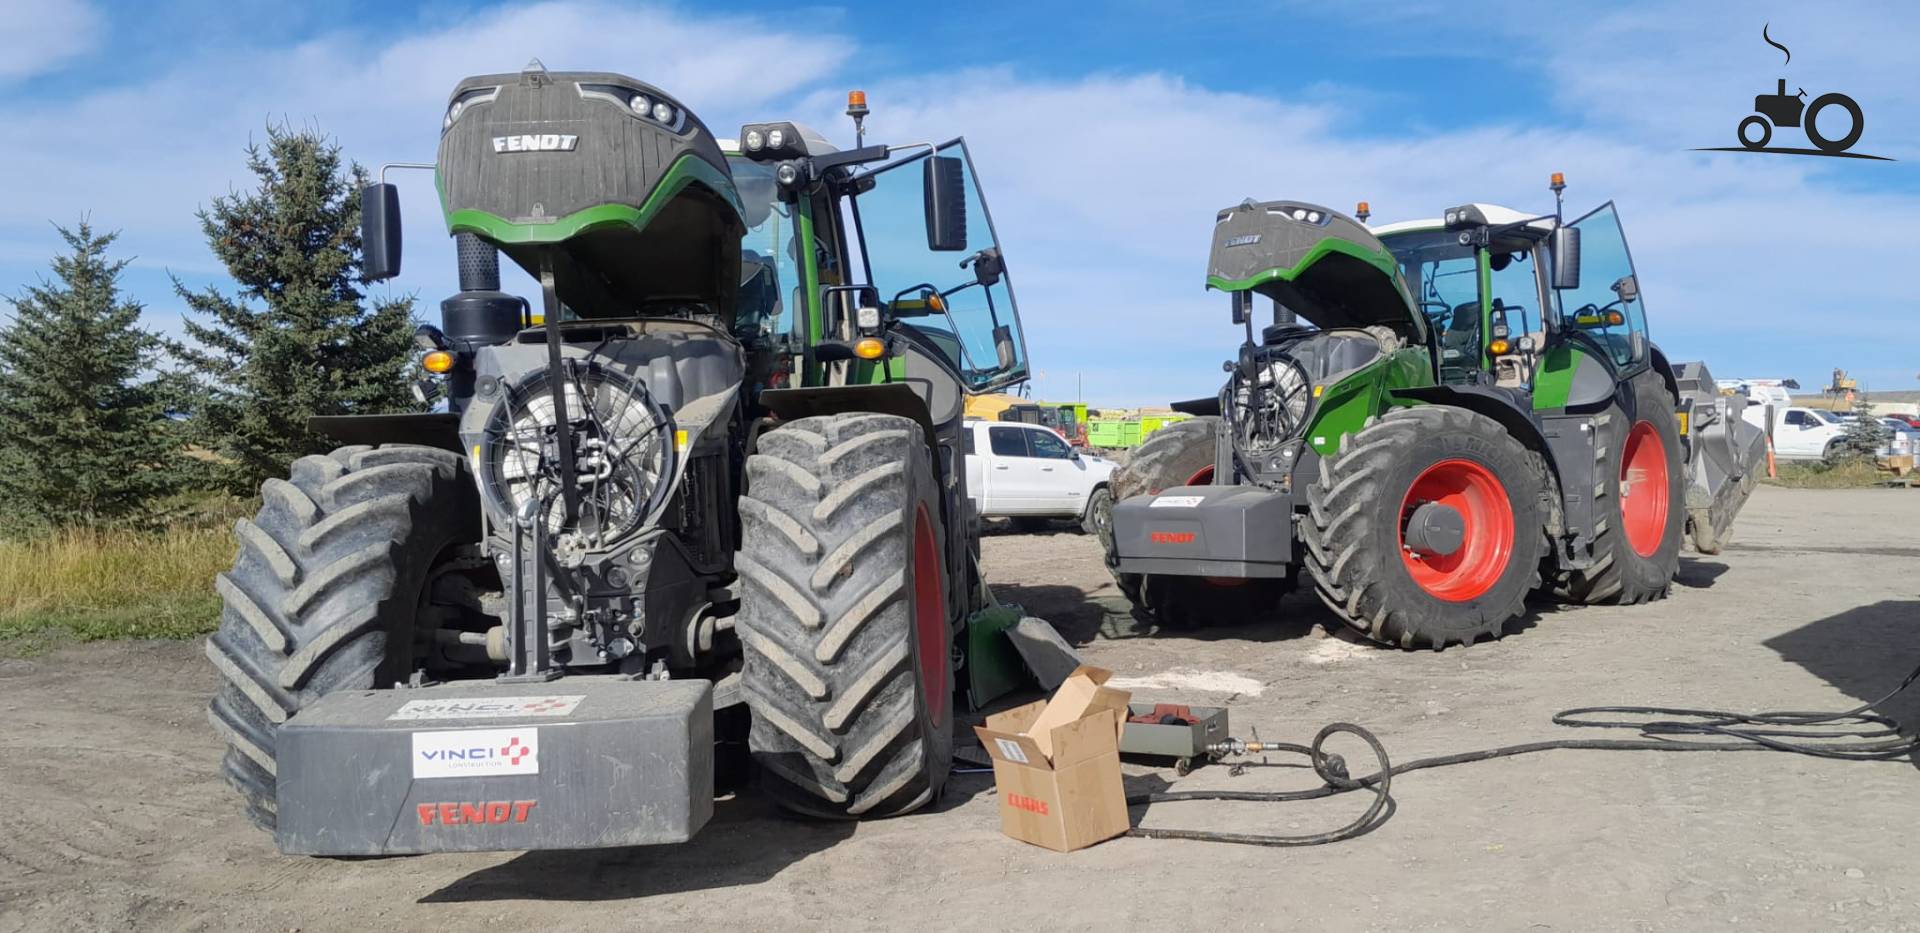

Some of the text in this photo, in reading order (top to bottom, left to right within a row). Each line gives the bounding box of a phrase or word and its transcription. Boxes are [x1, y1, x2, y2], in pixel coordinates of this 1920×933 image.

[493, 134, 578, 152] FENDT
[1151, 531, 1197, 545] FENDT
[422, 748, 494, 760] VINCI
[417, 800, 537, 826] FENDT
[1008, 792, 1049, 817] CLAAS
